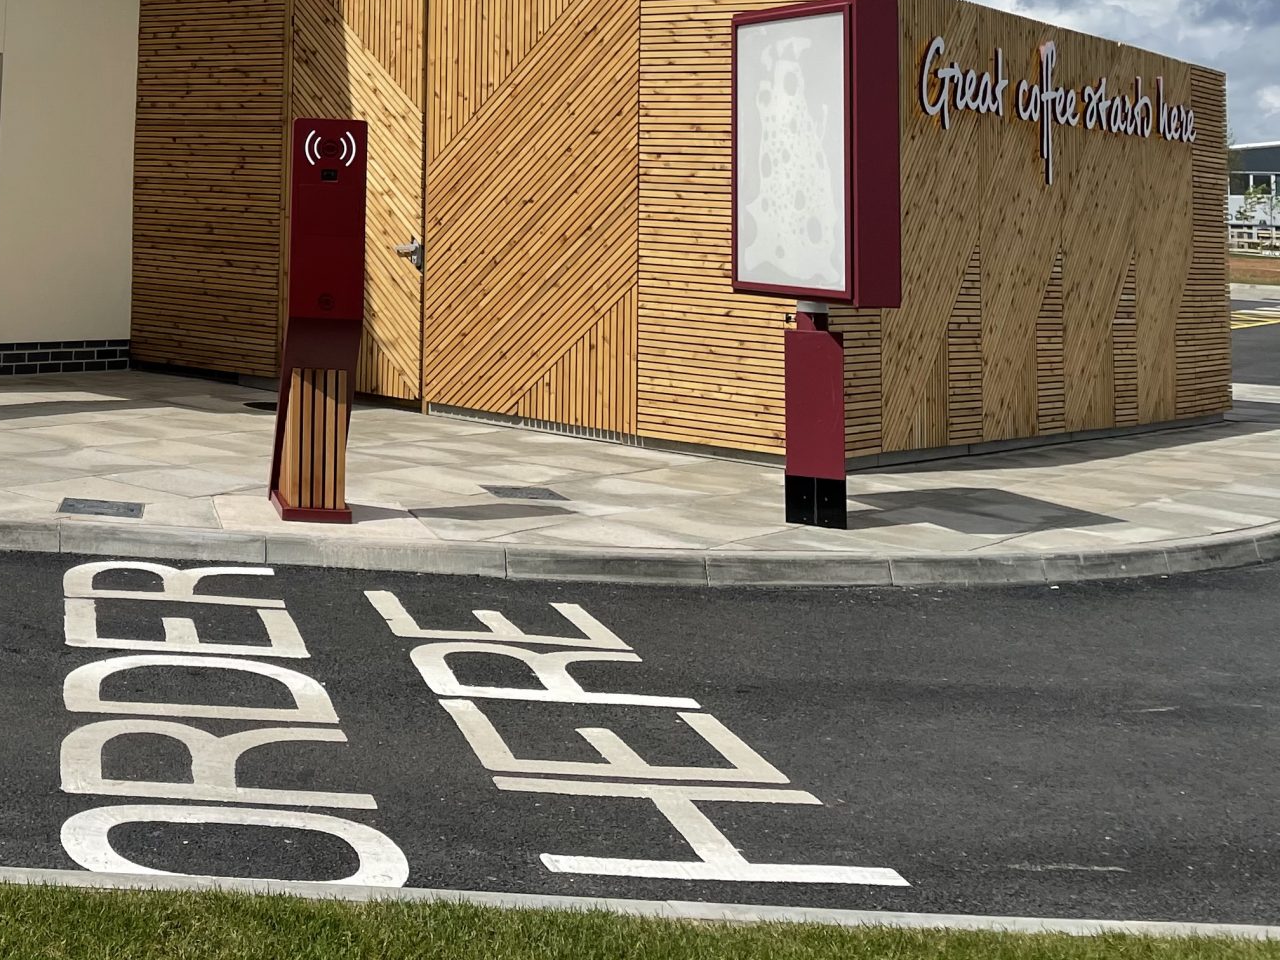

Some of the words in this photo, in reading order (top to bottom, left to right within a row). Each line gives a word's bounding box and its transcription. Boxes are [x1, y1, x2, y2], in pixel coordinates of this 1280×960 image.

[922, 36, 1008, 130] Great
[1018, 41, 1080, 185] coffee
[1083, 76, 1152, 138] starts
[1156, 76, 1197, 143] here
[59, 561, 410, 888] ORDER
[363, 590, 912, 887] HERE
